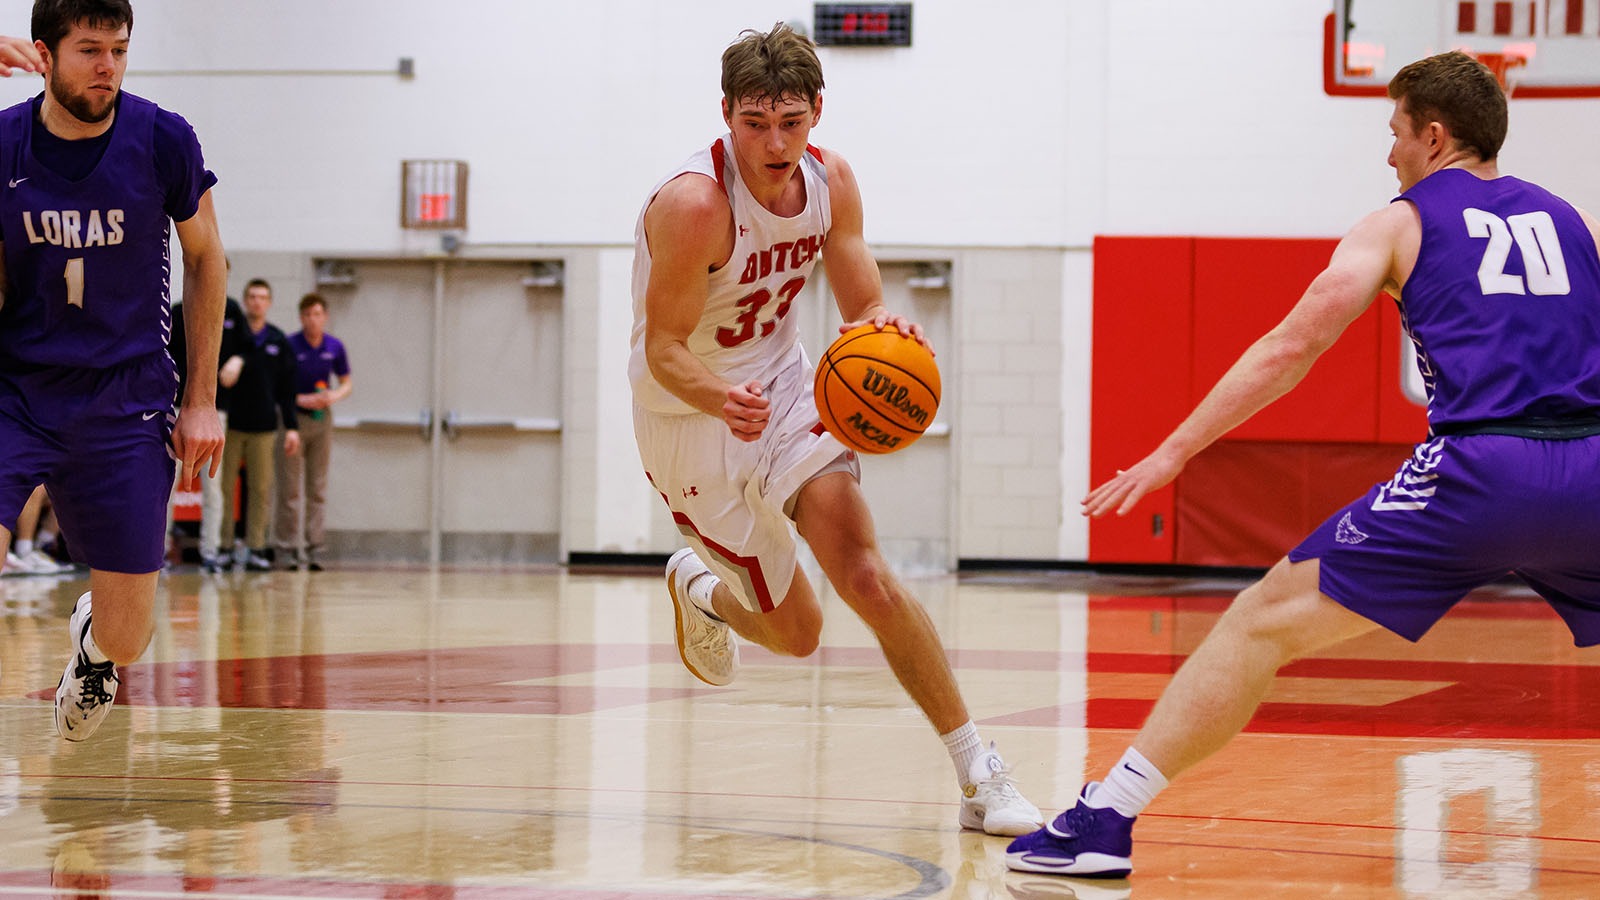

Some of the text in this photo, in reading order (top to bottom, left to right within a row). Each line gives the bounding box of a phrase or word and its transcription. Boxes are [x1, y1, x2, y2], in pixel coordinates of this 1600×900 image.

[22, 208, 125, 249] LORAS
[1462, 207, 1571, 296] 20
[63, 257, 85, 309] 1
[737, 234, 825, 285] DUTCH
[714, 275, 807, 348] 33
[862, 366, 929, 426] Wilson
[846, 411, 902, 448] NCAA
